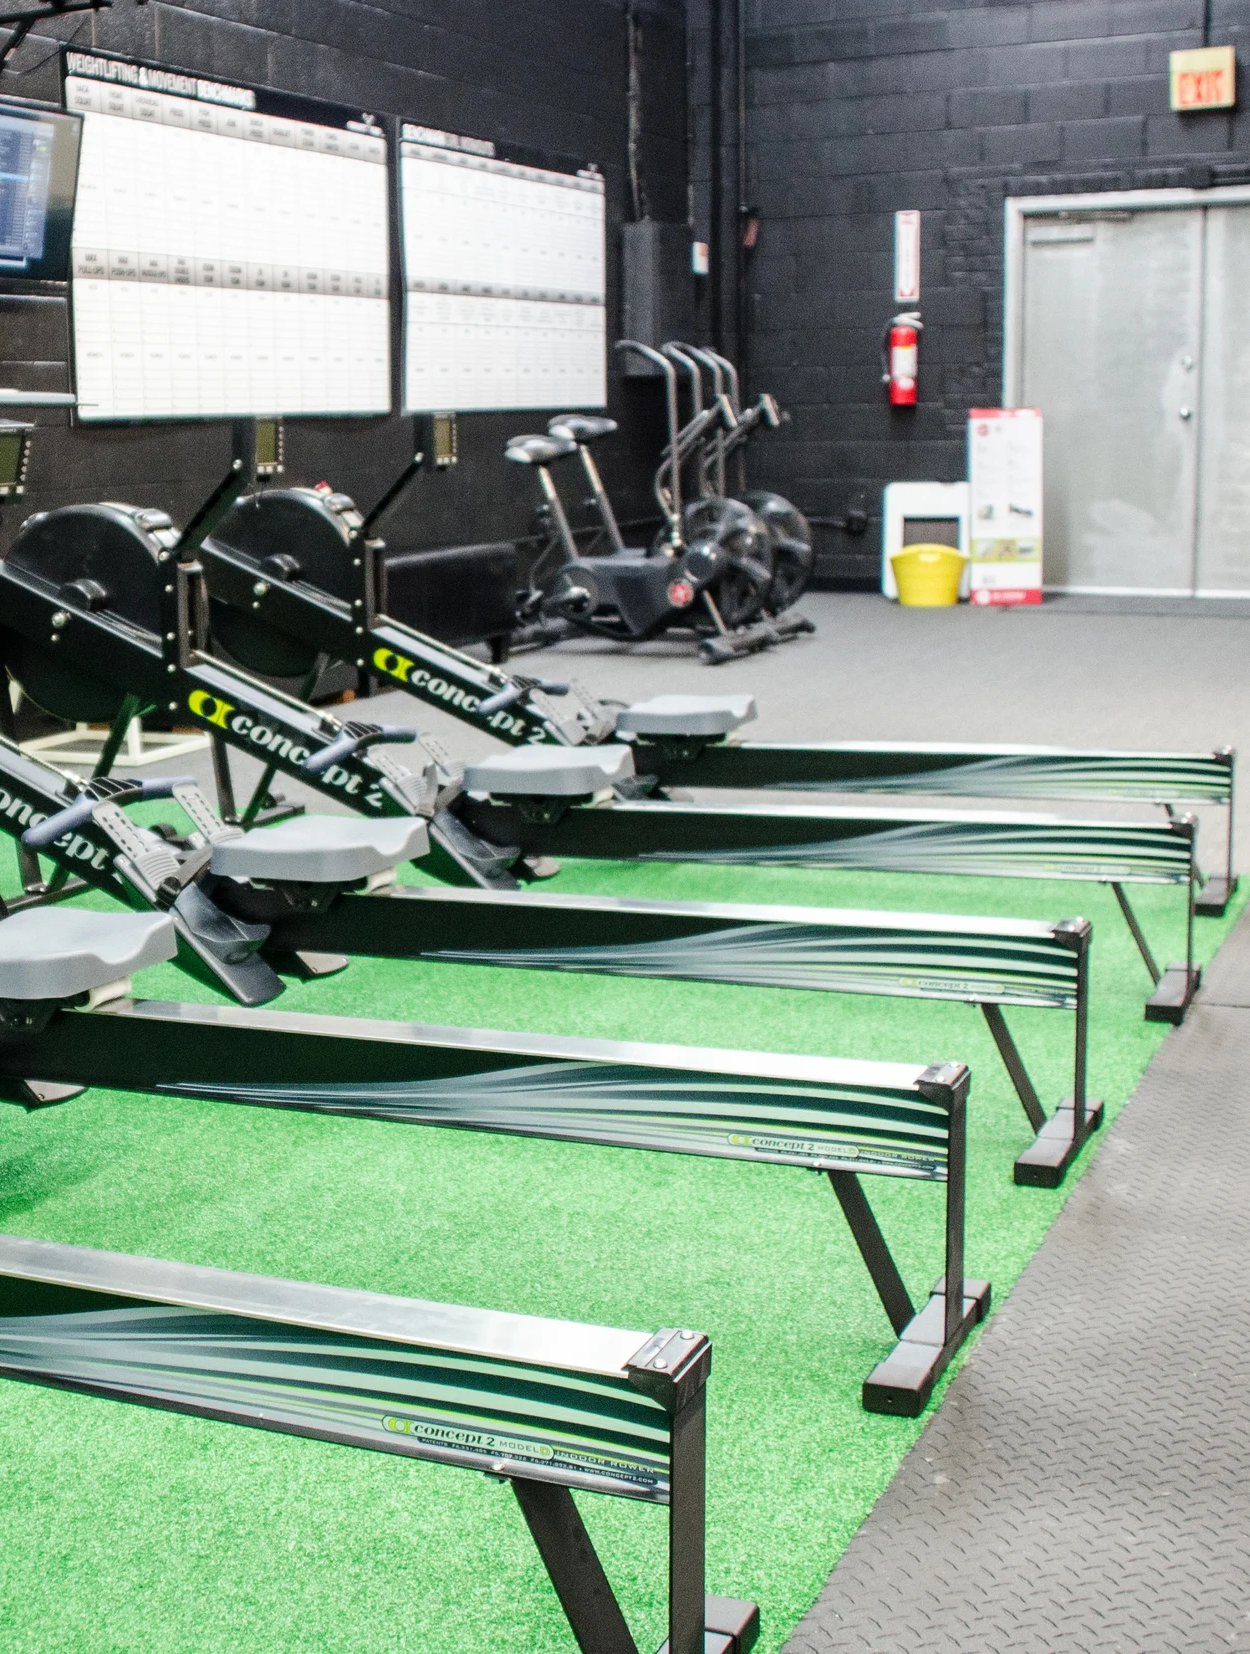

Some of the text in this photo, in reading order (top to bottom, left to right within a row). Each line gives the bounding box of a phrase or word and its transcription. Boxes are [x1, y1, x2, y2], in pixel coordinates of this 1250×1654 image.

[66, 51, 139, 83] WEIGHTLIFTING
[139, 66, 149, 87] &
[148, 68, 197, 96] MOVEMENT
[1179, 70, 1223, 106] EXIT
[411, 669, 527, 736] concpt
[231, 716, 363, 795] concpt
[752, 1138, 805, 1150] concept
[806, 1143, 814, 1151] 2
[414, 1424, 484, 1445] concept
[485, 1436, 495, 1447] 2
[499, 1440, 539, 1453] MODEL
[555, 1450, 606, 1465] INDOOR
[610, 1461, 655, 1474] ROWER
